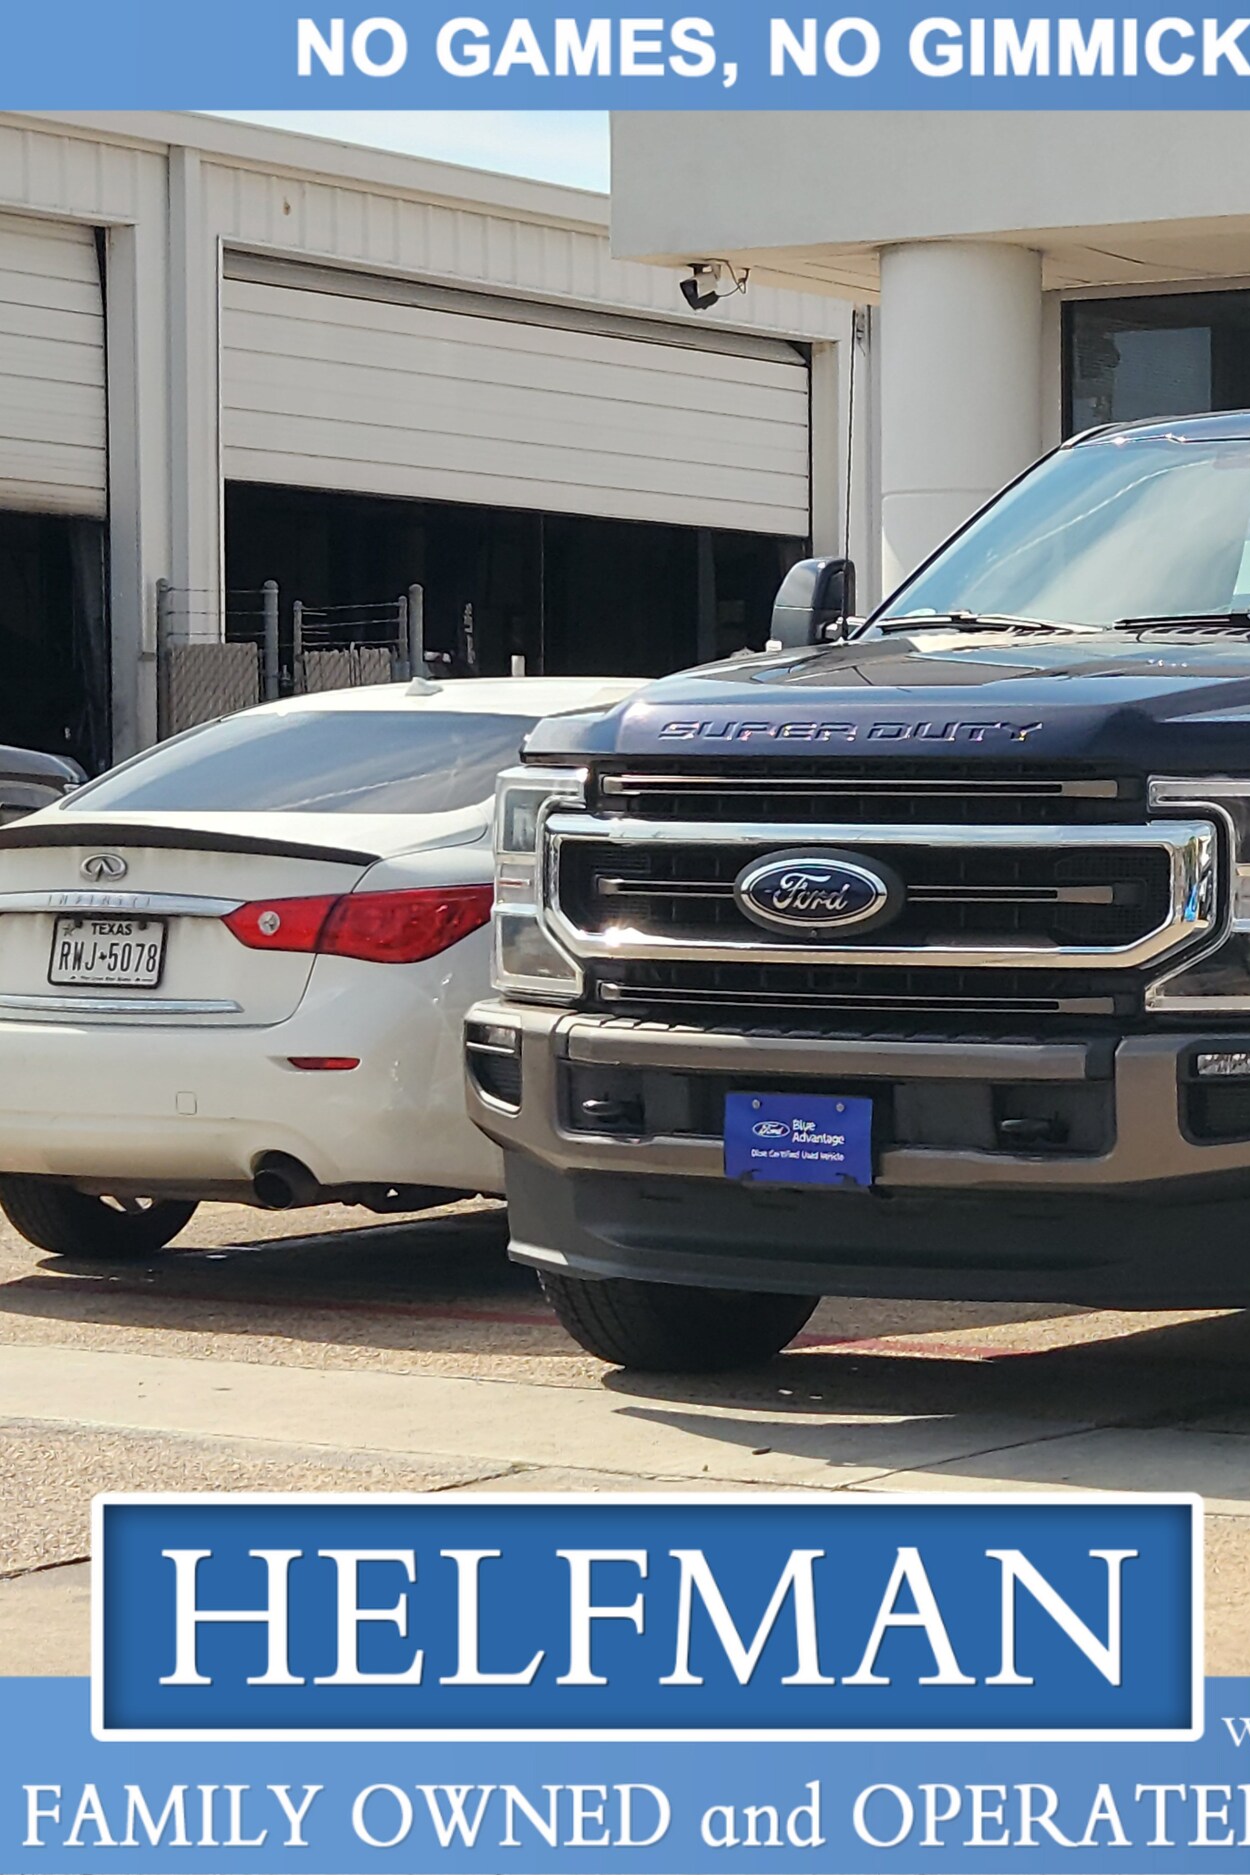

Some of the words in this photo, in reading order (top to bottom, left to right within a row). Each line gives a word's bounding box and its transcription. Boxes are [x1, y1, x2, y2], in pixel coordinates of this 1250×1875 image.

[657, 720, 859, 742] SUPER
[866, 721, 1043, 742] DUTY
[771, 873, 850, 911] Ford
[91, 922, 133, 936] TEXAS
[792, 1119, 816, 1131] Blue
[792, 1132, 845, 1147] Advantage
